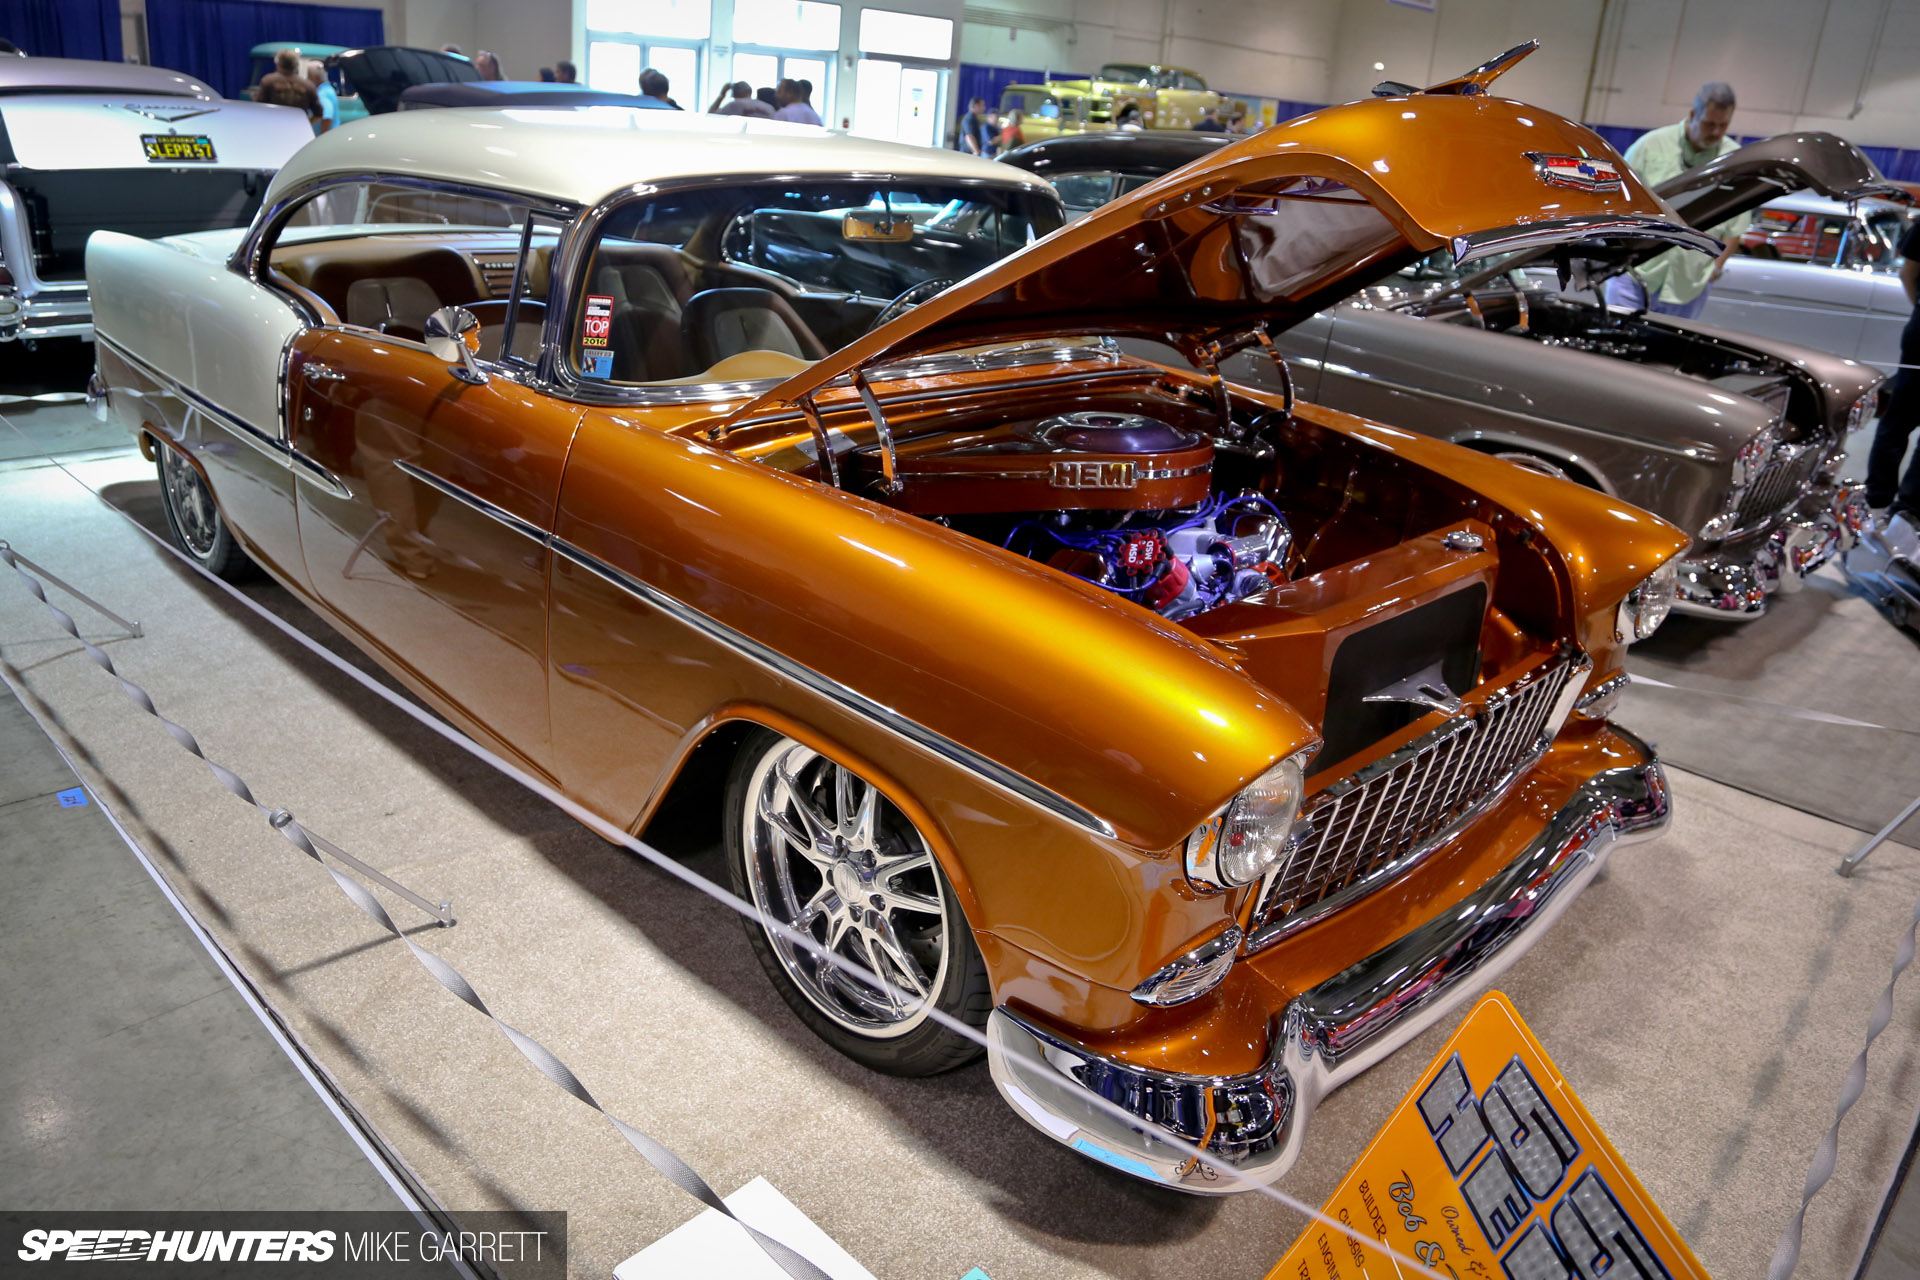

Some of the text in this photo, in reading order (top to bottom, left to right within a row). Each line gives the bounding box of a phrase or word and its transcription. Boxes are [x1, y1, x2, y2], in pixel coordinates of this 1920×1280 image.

[145, 143, 213, 158] SLEPR 57
[585, 320, 609, 334] TOP
[1053, 462, 1135, 487] HEMI
[1128, 543, 1139, 563] MSD
[1144, 540, 1154, 560] MSD
[1358, 1180, 1387, 1241] BUILDER
[1389, 1168, 1428, 1232] Bob
[1441, 1205, 1475, 1256] Owned
